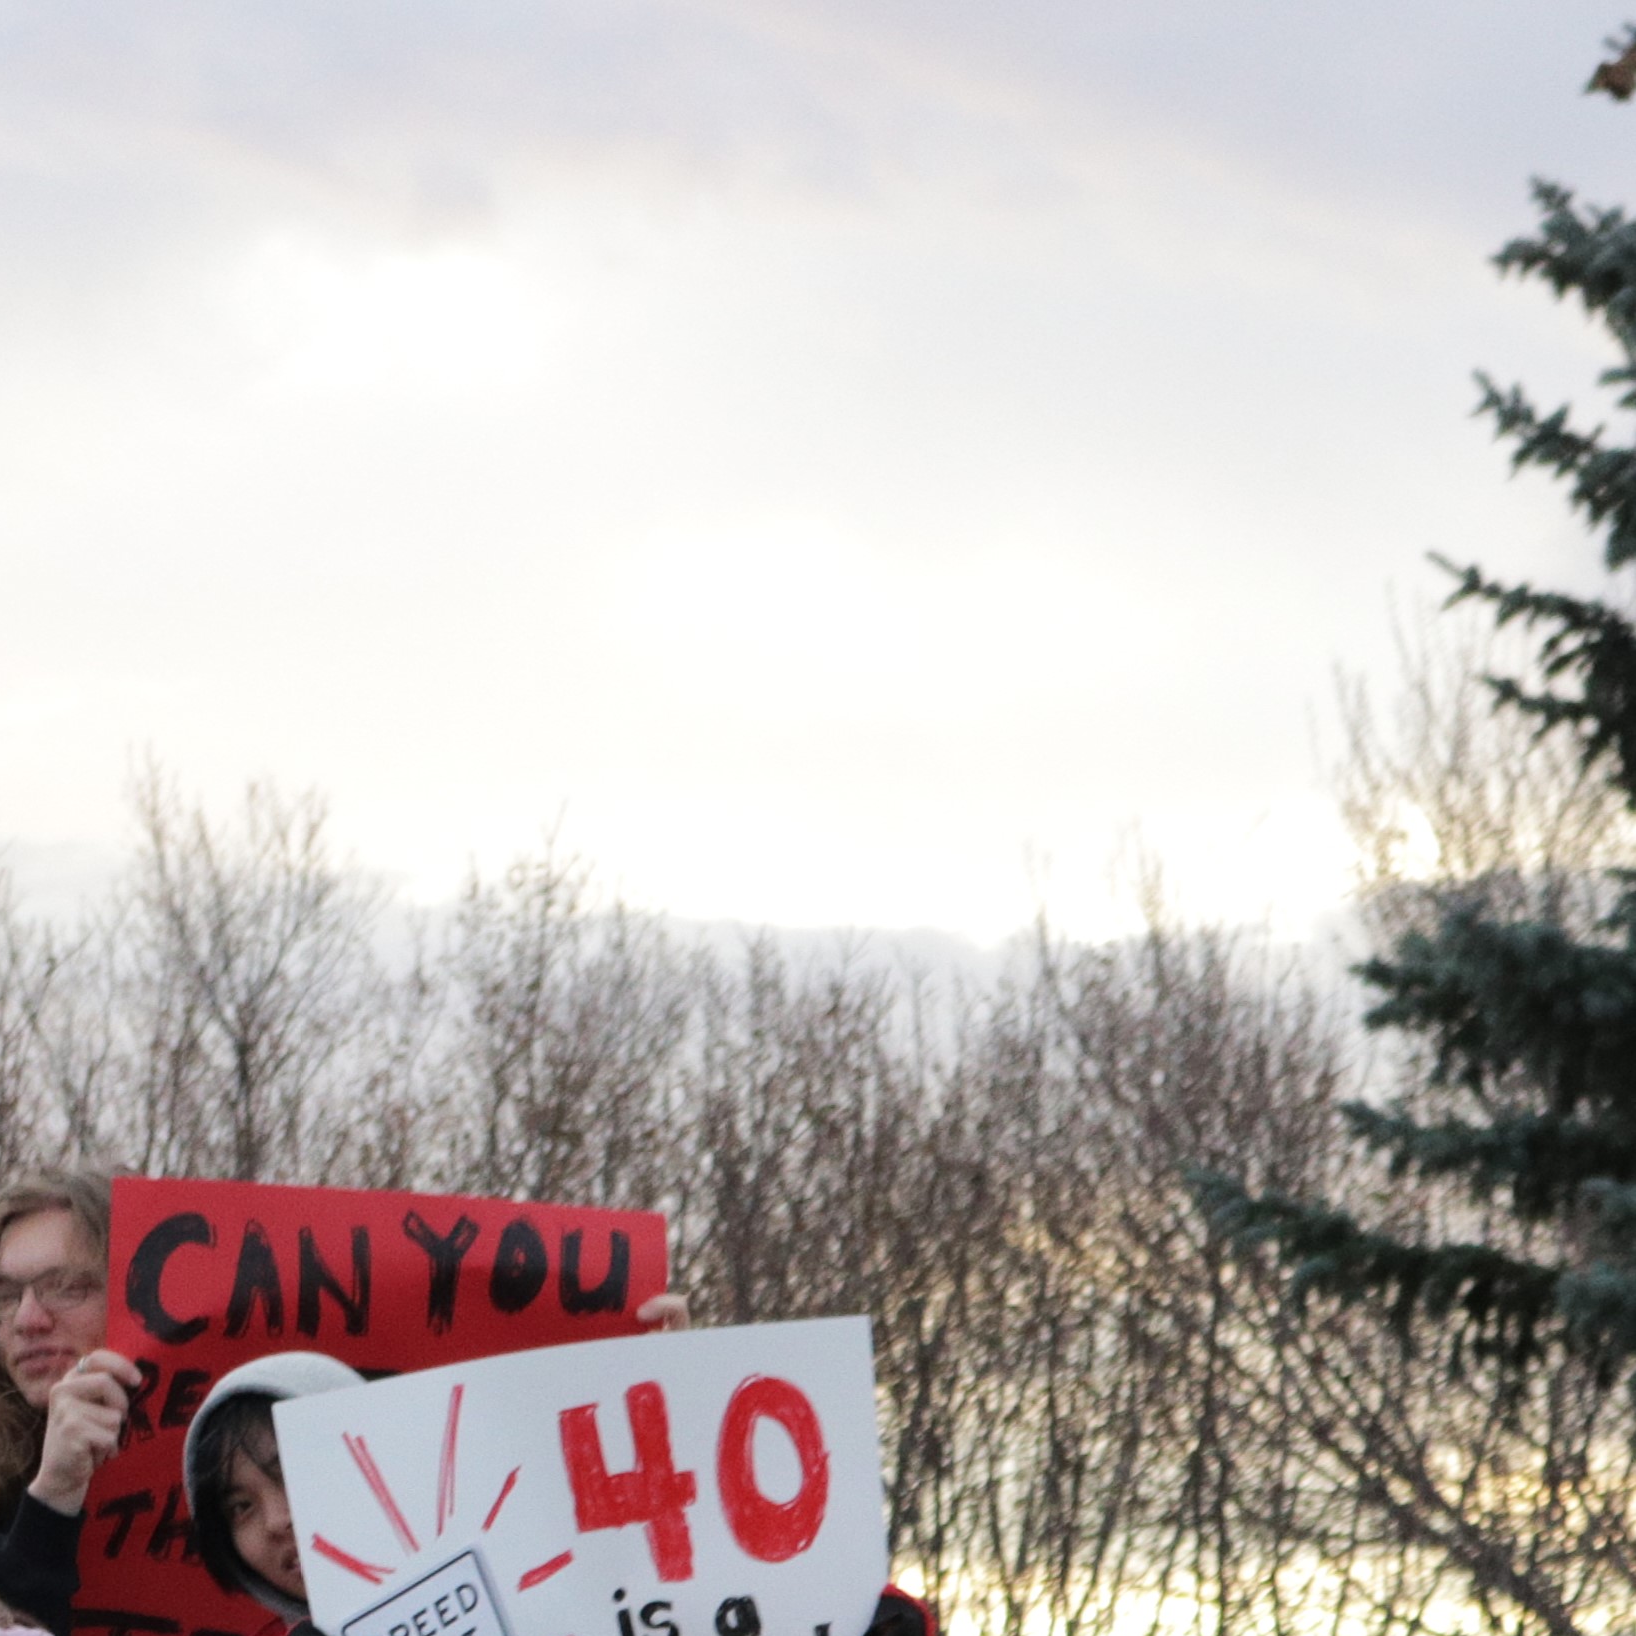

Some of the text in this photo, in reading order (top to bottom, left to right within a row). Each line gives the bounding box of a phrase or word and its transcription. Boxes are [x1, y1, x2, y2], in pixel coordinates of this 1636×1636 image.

[127, 1208, 630, 1344] CAN YOU
[557, 1373, 831, 1583] 40
